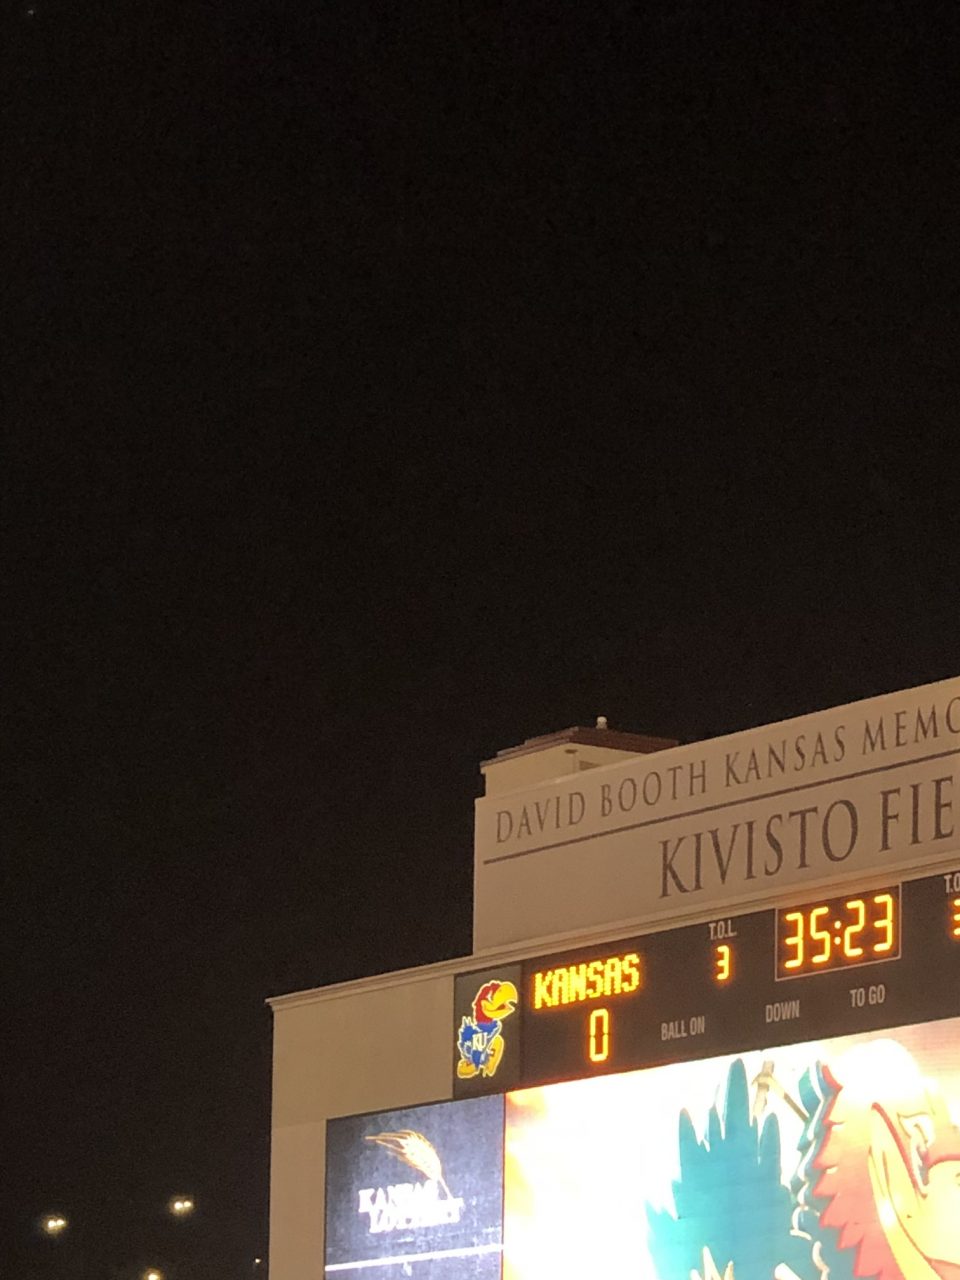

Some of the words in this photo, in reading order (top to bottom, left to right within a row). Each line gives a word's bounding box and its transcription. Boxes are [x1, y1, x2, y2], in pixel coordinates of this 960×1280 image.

[496, 792, 585, 843] DAVID
[601, 760, 706, 817] BOOTH
[725, 726, 846, 787] KANSAS
[659, 800, 858, 898] KIVISTO
[709, 920, 737, 940] T.O.L.
[785, 894, 893, 968] 35:23
[533, 953, 641, 1009] KANSAS
[717, 944, 730, 980] 3
[765, 1000, 800, 1023] DOWN
[850, 988, 865, 1008] TO
[868, 984, 885, 1004] GO
[589, 1008, 609, 1062] 0
[661, 1017, 688, 1041] BALL
[690, 1016, 705, 1036] ON
